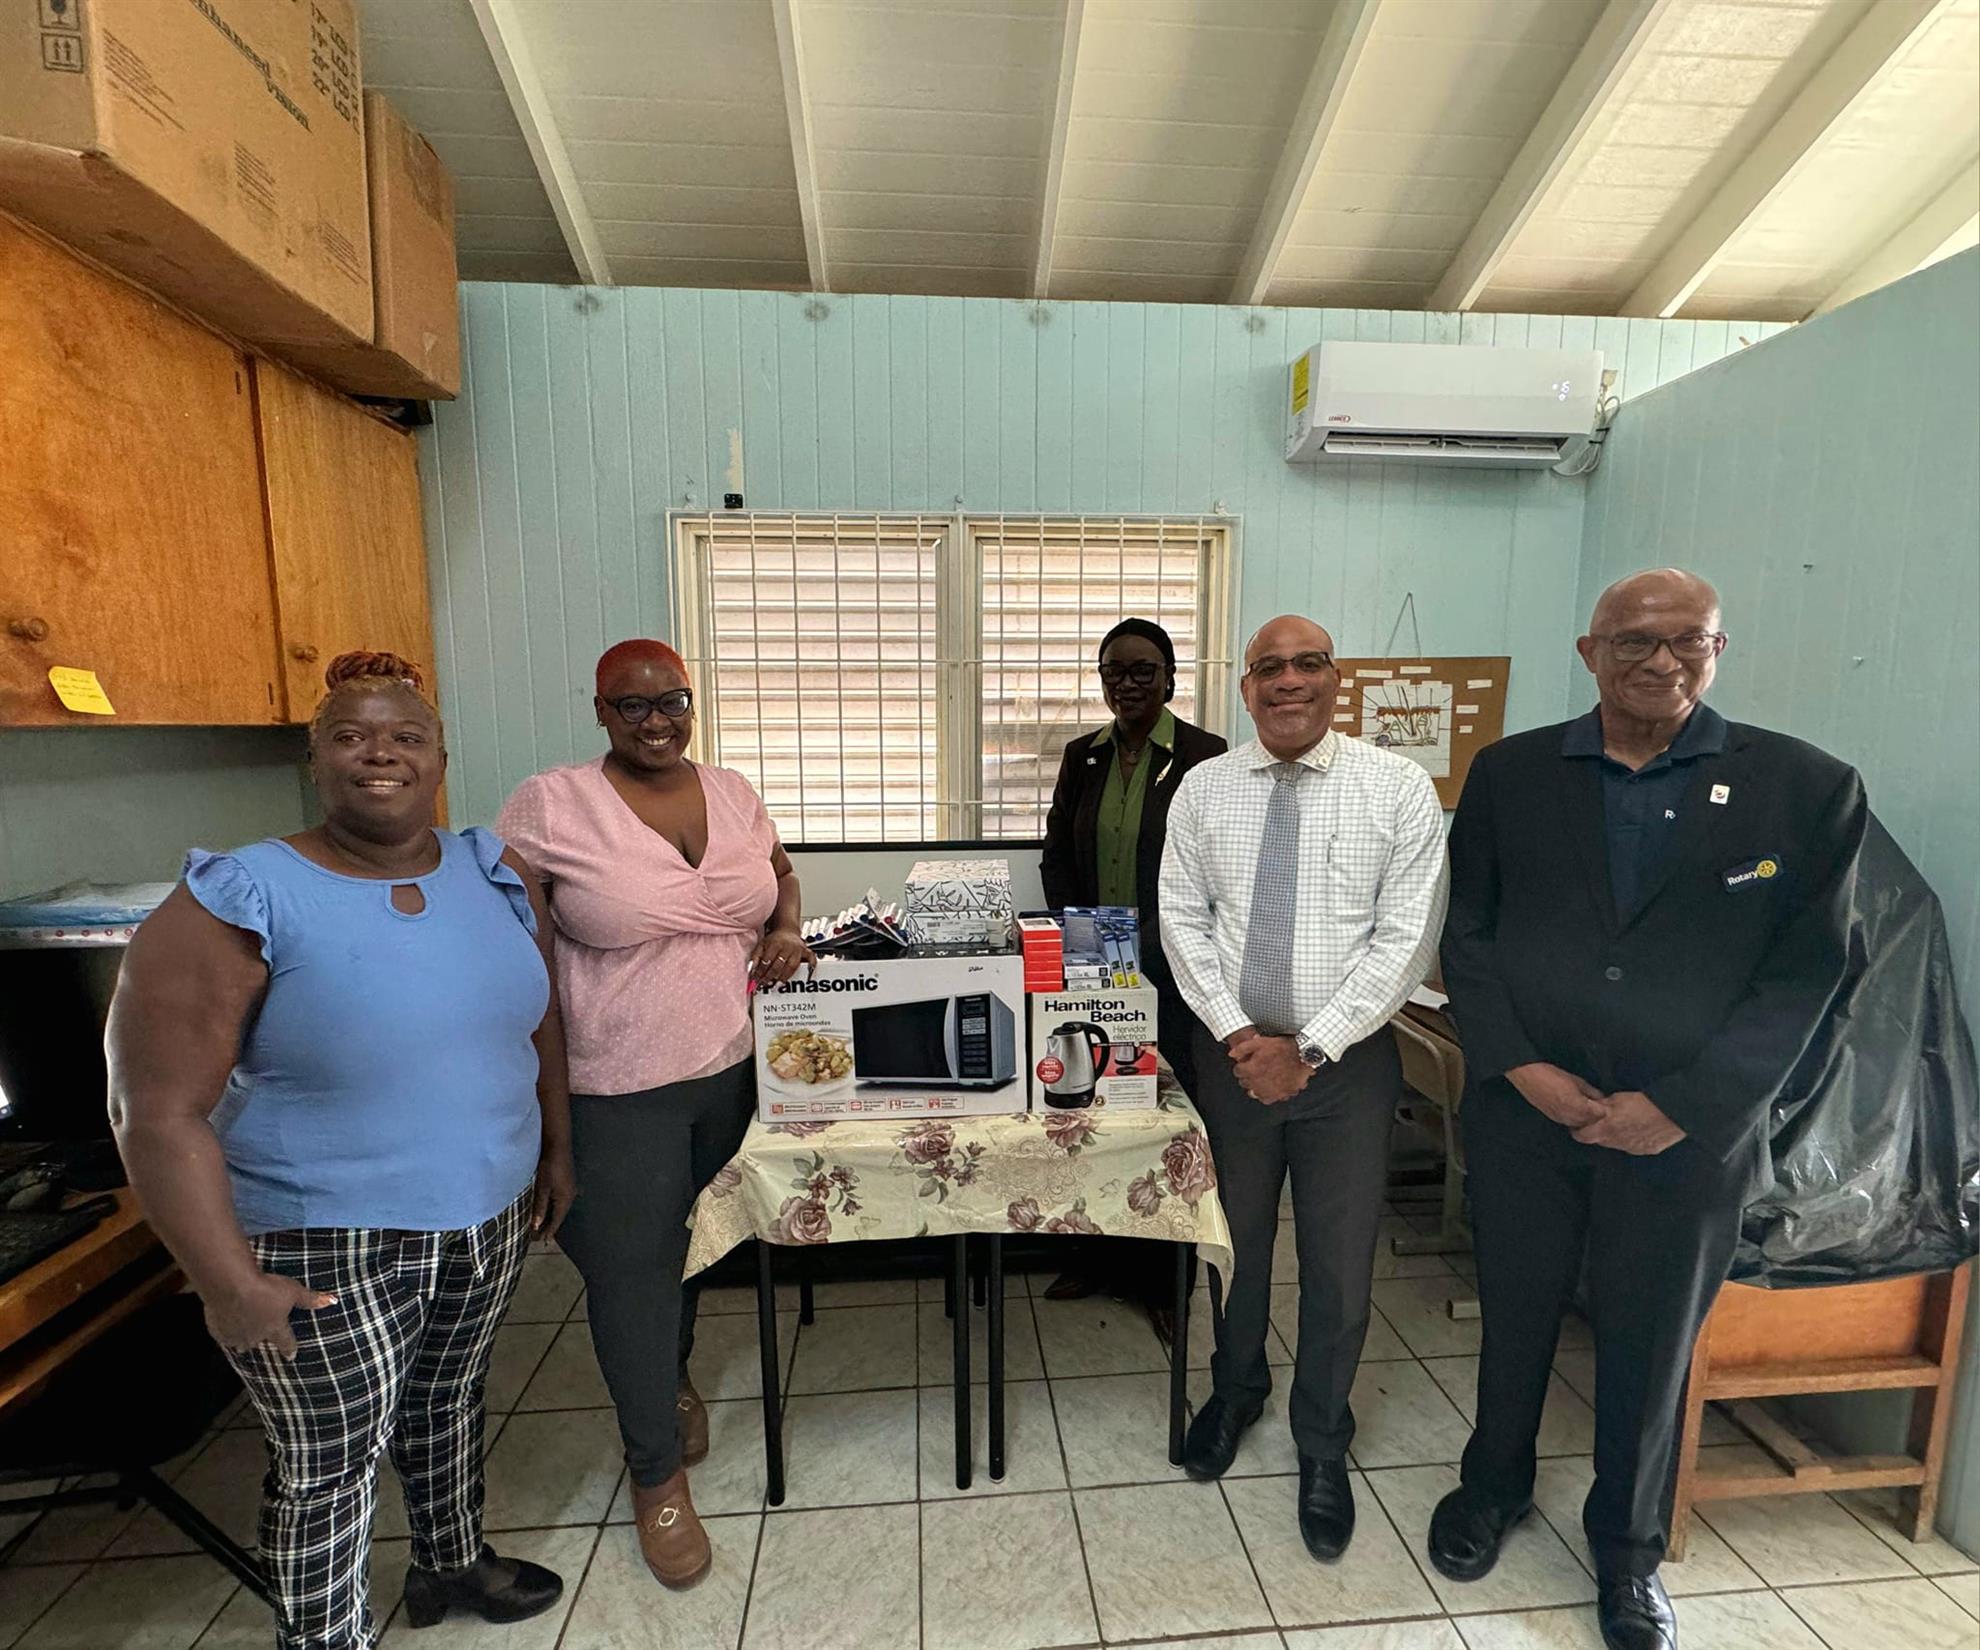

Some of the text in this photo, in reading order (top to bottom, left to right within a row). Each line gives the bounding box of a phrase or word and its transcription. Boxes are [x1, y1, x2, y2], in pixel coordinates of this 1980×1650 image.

[190, 0, 271, 79] nhanced
[1727, 869, 1759, 886] Rotary
[763, 1003, 816, 1013] NN-ST342M
[1044, 999, 1125, 1012] Hamilton
[1090, 1010, 1146, 1023] Beach
[1113, 1025, 1147, 1033] Hervidor
